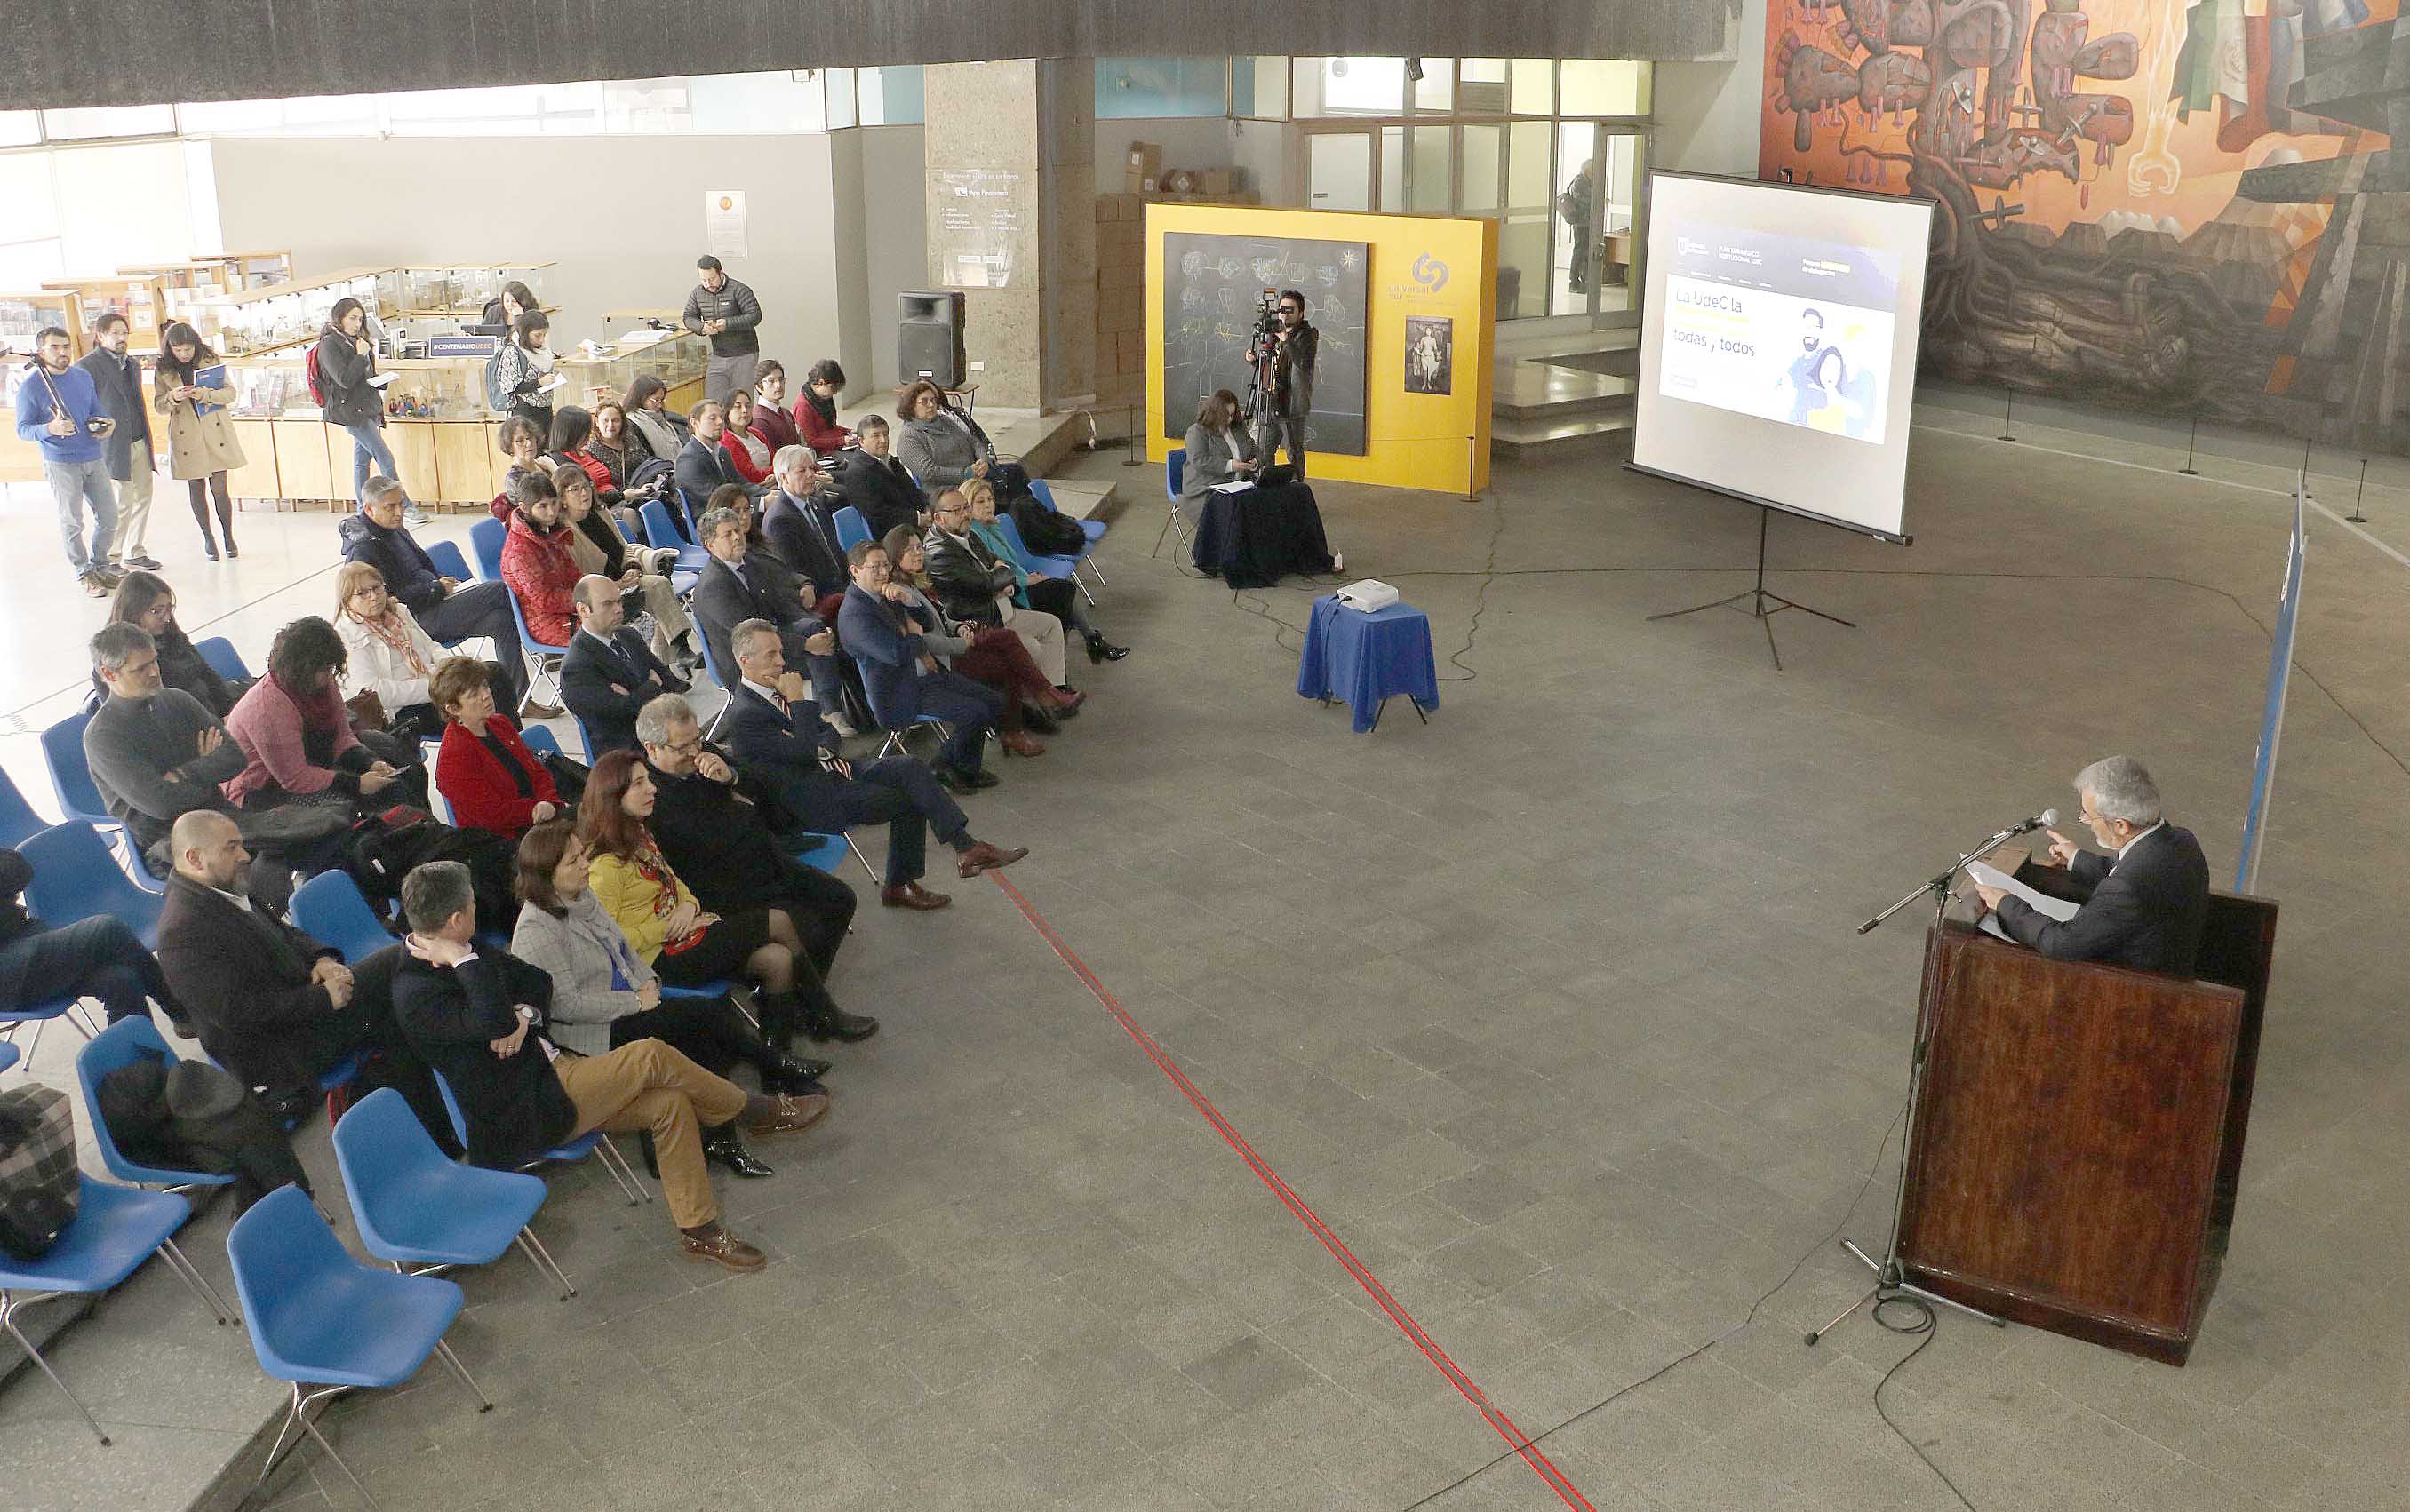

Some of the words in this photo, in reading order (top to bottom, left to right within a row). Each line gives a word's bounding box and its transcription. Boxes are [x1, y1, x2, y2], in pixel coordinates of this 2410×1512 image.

[1694, 290, 1728, 310] UdeC
[1731, 298, 1742, 313] la
[1673, 328, 1707, 346] todas
[1720, 336, 1755, 356] todos
